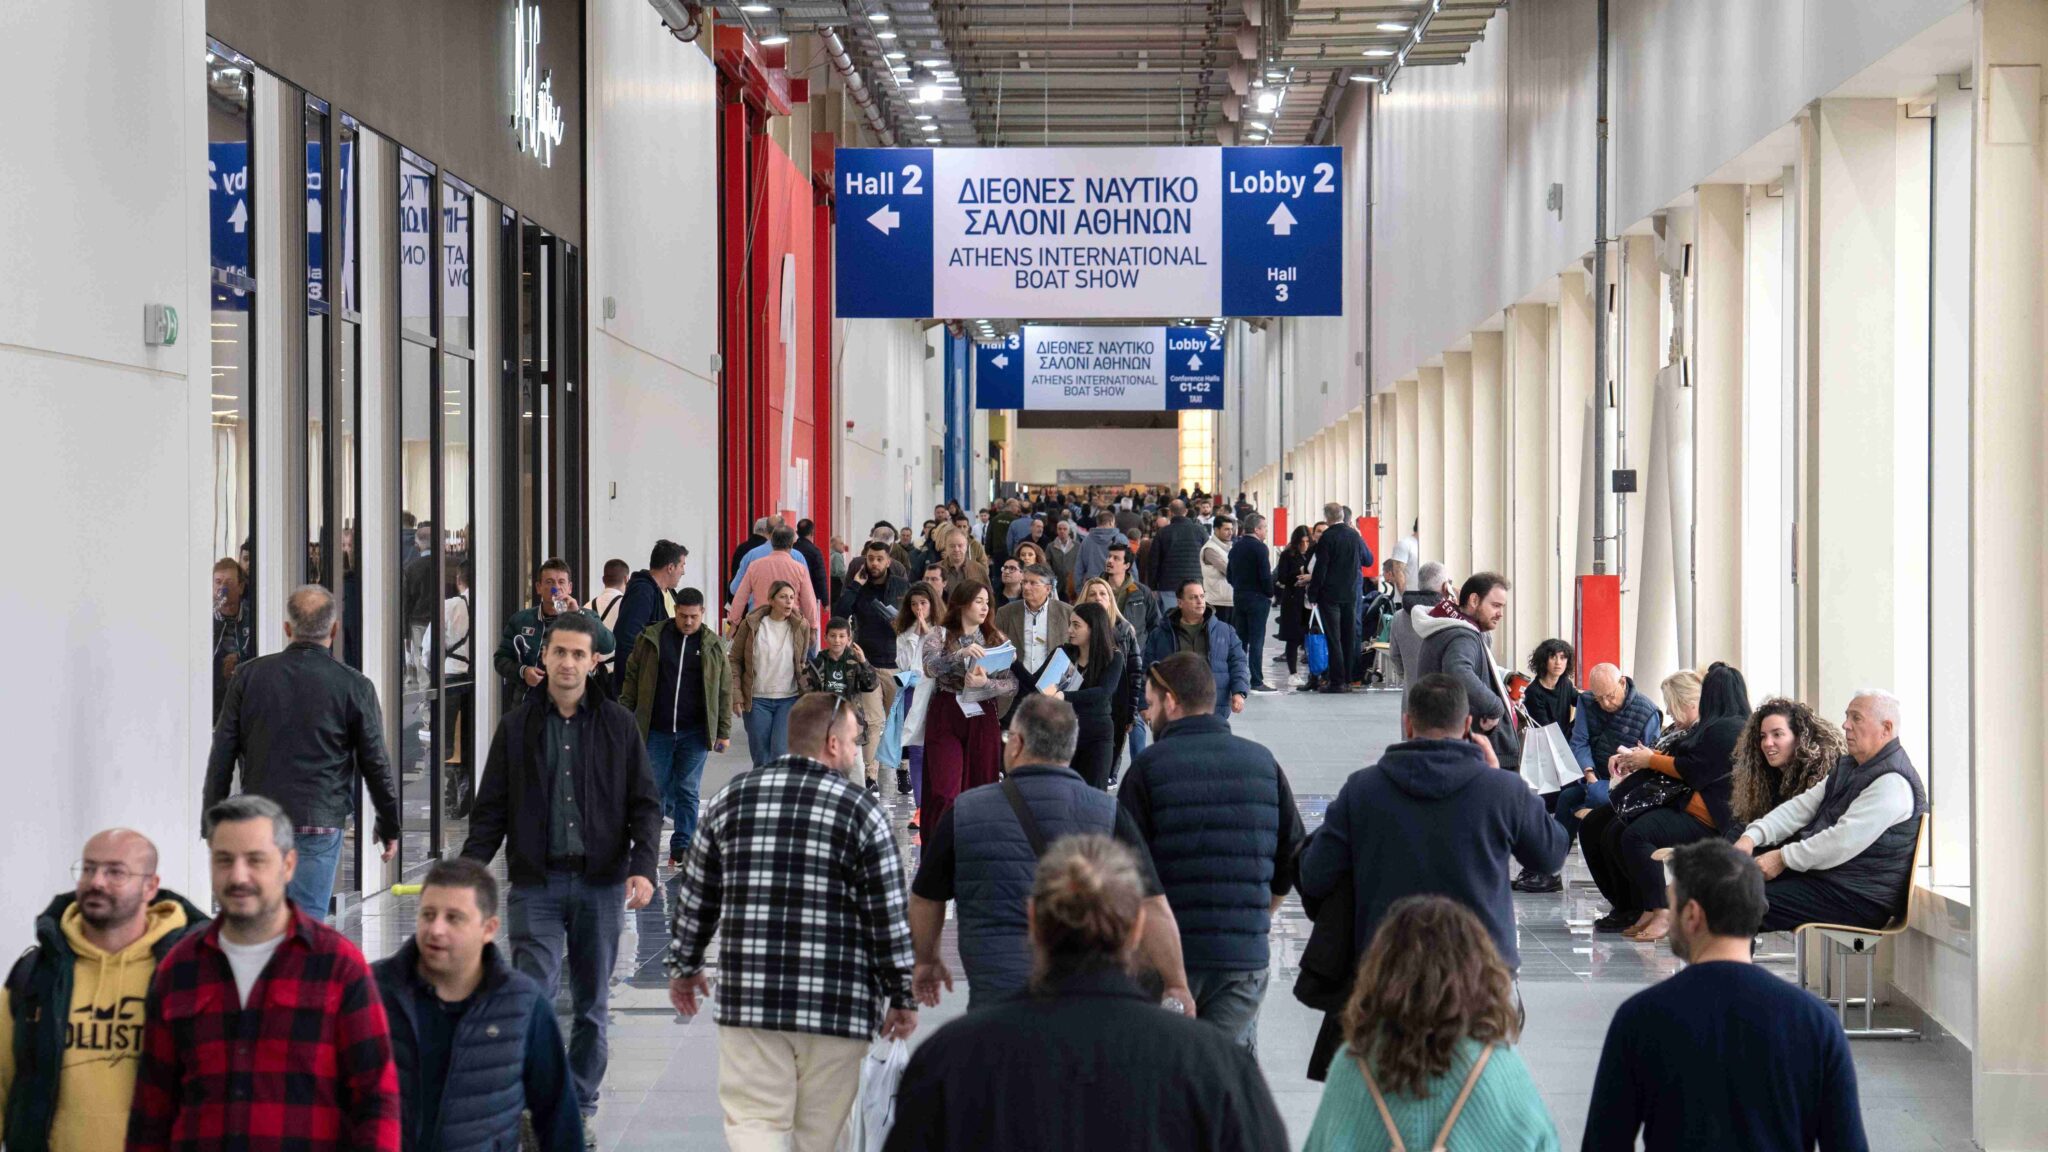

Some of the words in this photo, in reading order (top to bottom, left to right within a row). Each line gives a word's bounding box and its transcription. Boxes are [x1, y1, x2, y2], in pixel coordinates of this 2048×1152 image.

[846, 171, 894, 195] Hall
[901, 163, 924, 195] 2
[1230, 169, 1307, 199] Lobby
[1313, 162, 1335, 193] 2
[957, 177, 1076, 204] ΔΙΕΘΝΕΣ
[1085, 176, 1199, 204] ΝΑΥΤΙΚΟ
[964, 208, 1066, 236] ΣΑΛΟΝΙ
[1073, 207, 1191, 235] ΑΘΗΝΩΝ
[948, 247, 1034, 267] ATHENS
[1039, 246, 1208, 266] INTERNATIONAL
[1015, 269, 1072, 289] BOAT
[1075, 269, 1140, 289] SHOW
[1267, 266, 1298, 282] Hall
[1275, 283, 1289, 302] 3
[1008, 334, 1021, 350] 3
[1036, 340, 1095, 355] ΔΙΕΘΝΕΣ
[1098, 340, 1155, 355] ΝΑΥΤΙΚΟ
[1168, 338, 1208, 353] Lobby
[1209, 334, 1222, 350] 2
[1039, 356, 1090, 370] ΣΑΛΟΝΙ
[1093, 356, 1152, 370] ΑΘΗΝΩΝ
[1031, 375, 1074, 386] ATHENS
[1075, 375, 1159, 386] INTERNATIONAL
[1179, 382, 1211, 392] C1-C2
[1063, 386, 1092, 397] BOAT
[1093, 386, 1126, 397] SHOW
[65, 1022, 145, 1051] OLLIST
